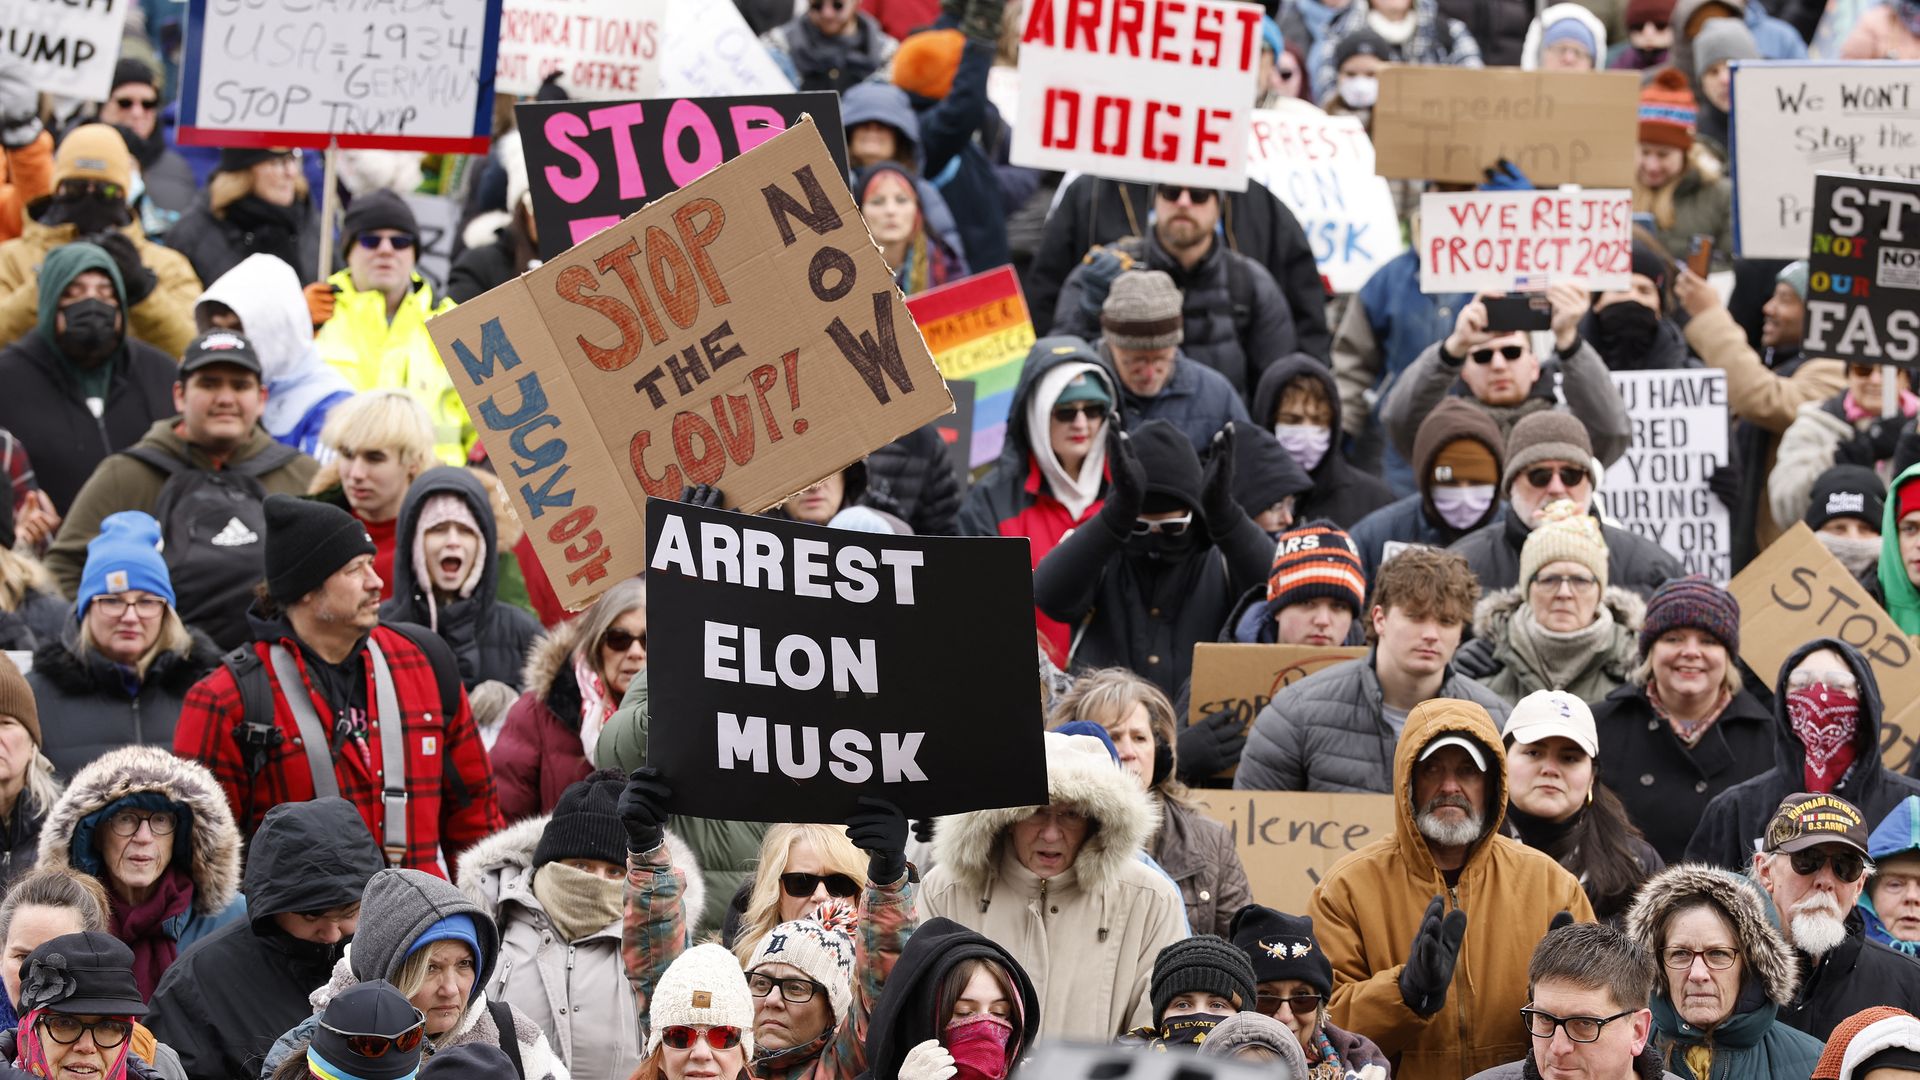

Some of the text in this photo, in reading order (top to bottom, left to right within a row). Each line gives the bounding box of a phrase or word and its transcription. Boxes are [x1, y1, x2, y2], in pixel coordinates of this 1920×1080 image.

[0, 27, 95, 68] UMP
[223, 22, 327, 73] USA
[361, 23, 477, 63] 1934
[1022, 0, 1261, 71] ARREST
[573, 60, 641, 92] OFFICE
[1776, 82, 1823, 114] We
[209, 80, 417, 134] STOP TRUMP
[1042, 88, 1231, 167] DOGE
[1249, 121, 1364, 162] RREST
[1795, 123, 1914, 163] Stop the
[1448, 196, 1632, 232] WE REJECT
[1829, 185, 1920, 241] ST
[1431, 237, 1571, 275] PROJECT
[1813, 232, 1867, 259] NOT
[556, 197, 732, 371] STOP
[761, 164, 915, 405] NOW
[1810, 271, 1870, 297] OUR
[1803, 299, 1920, 361] FAS
[634, 320, 748, 410] THE
[1650, 375, 1728, 410] HAVE
[630, 348, 808, 501] COUP!
[451, 316, 612, 587] MUSK OUT
[650, 513, 924, 605] ARREST
[1680, 522, 1717, 551] OR
[1771, 566, 1912, 668] STOP
[704, 620, 879, 694] ELON
[717, 711, 929, 784] MUSK
[1199, 799, 1369, 850] ilence
[1788, 796, 1827, 820] VIETNAM
[1828, 797, 1861, 825] VETERAN
[1174, 1021, 1217, 1030] ELEVATE
